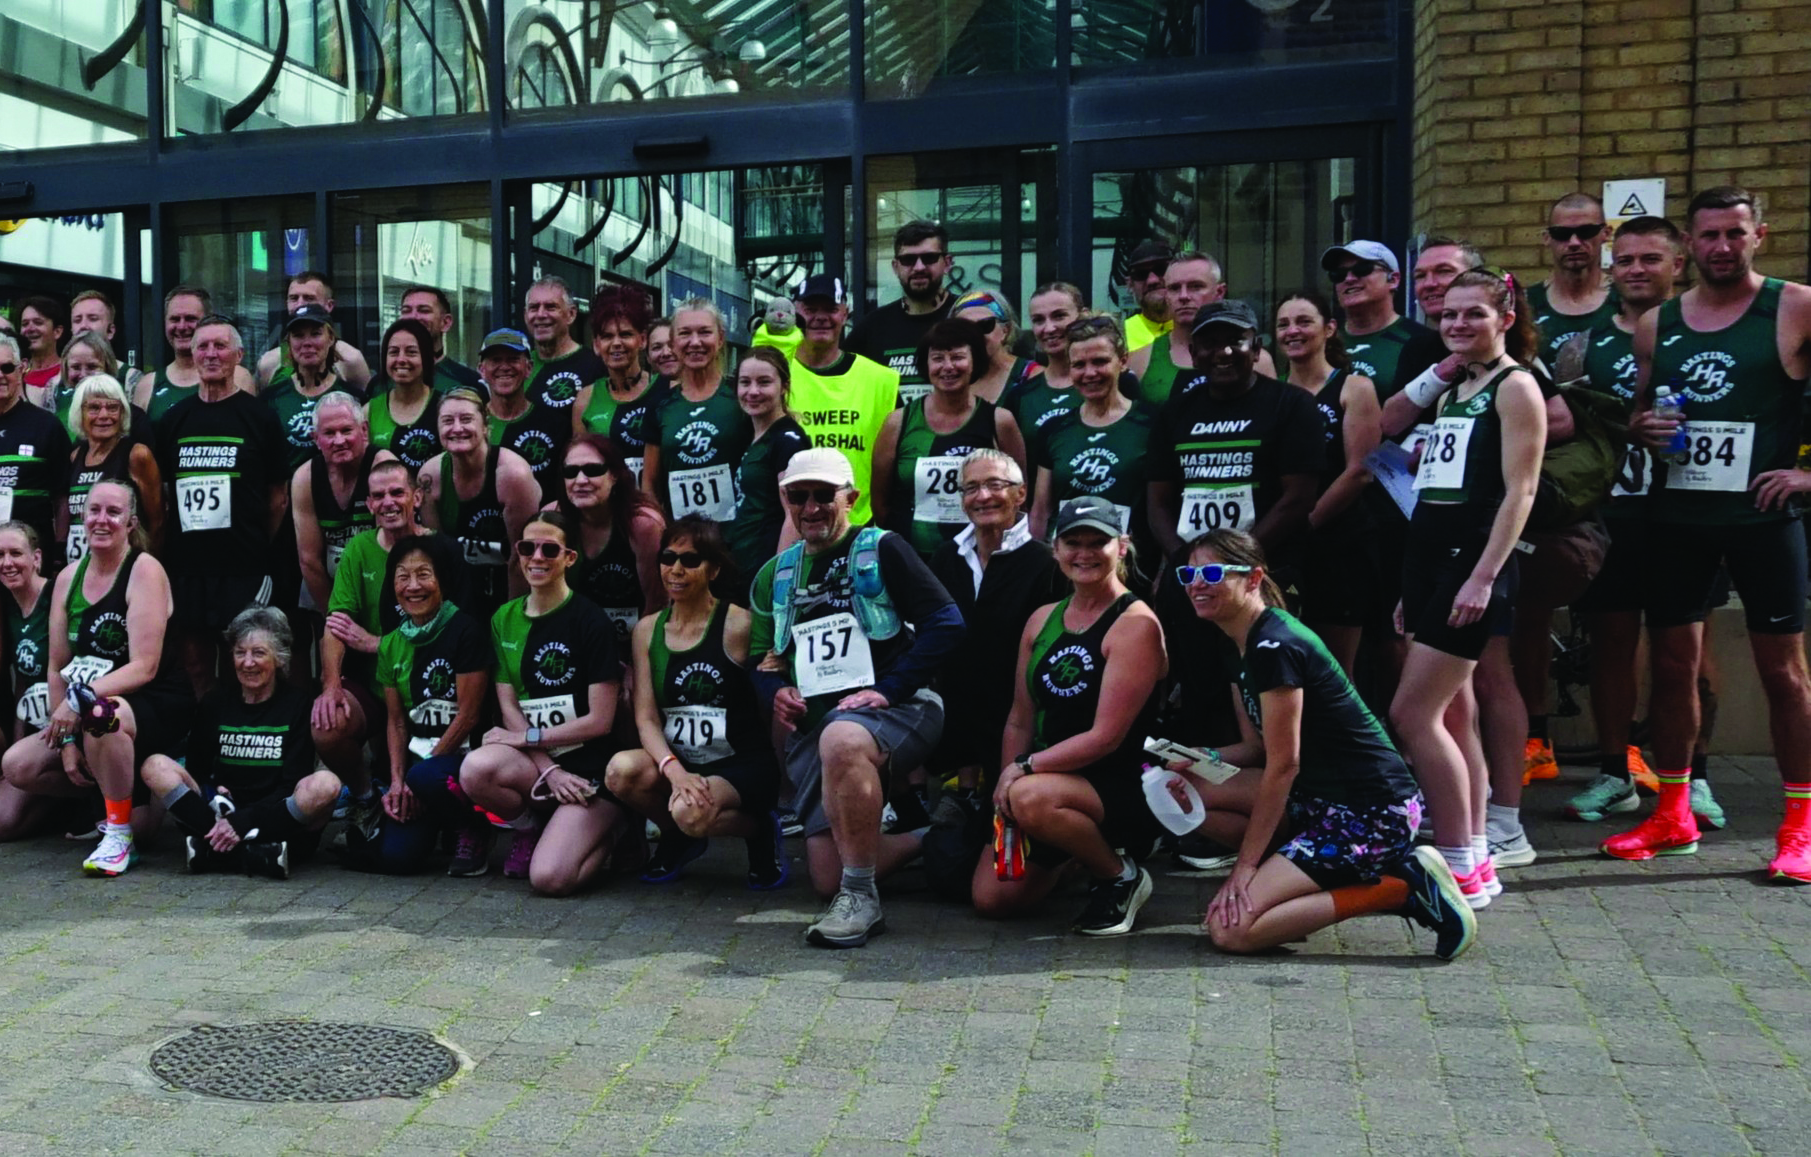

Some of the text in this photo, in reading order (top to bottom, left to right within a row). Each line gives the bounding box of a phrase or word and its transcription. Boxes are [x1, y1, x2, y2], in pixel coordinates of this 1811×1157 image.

[1680, 351, 1736, 372] HASTINGS
[1688, 363, 1727, 389] HR
[803, 410, 860, 426] SWEEP
[1190, 419, 1252, 435] DANNY
[675, 422, 719, 440] HASTINGS
[1725, 427, 1747, 435] MILE
[179, 446, 238, 457] HASTINGS
[680, 431, 711, 453] HR
[810, 433, 866, 451] ARSHAL
[179, 457, 237, 468] RUNNERS
[677, 447, 718, 464] RUNNERS
[1069, 449, 1119, 469] HASTINGS
[1180, 452, 1253, 468] HASTINGS
[1074, 459, 1110, 482] HR
[1184, 465, 1253, 480] RUNNERS
[679, 479, 721, 508] 181
[1069, 476, 1116, 493] RUNNERS
[184, 487, 220, 513] 495
[1189, 501, 1241, 530] 409
[807, 626, 853, 664] 157
[18, 648, 35, 668] HR
[1049, 645, 1094, 672] HASTINGS
[533, 665, 577, 688] RUNNERS
[675, 661, 724, 687] HASTINGS
[1050, 656, 1081, 684] HR
[1042, 673, 1088, 698] RUNNERS
[219, 733, 282, 747] HASTINGS
[673, 719, 714, 747] 219
[220, 746, 282, 760] RUNNERS
